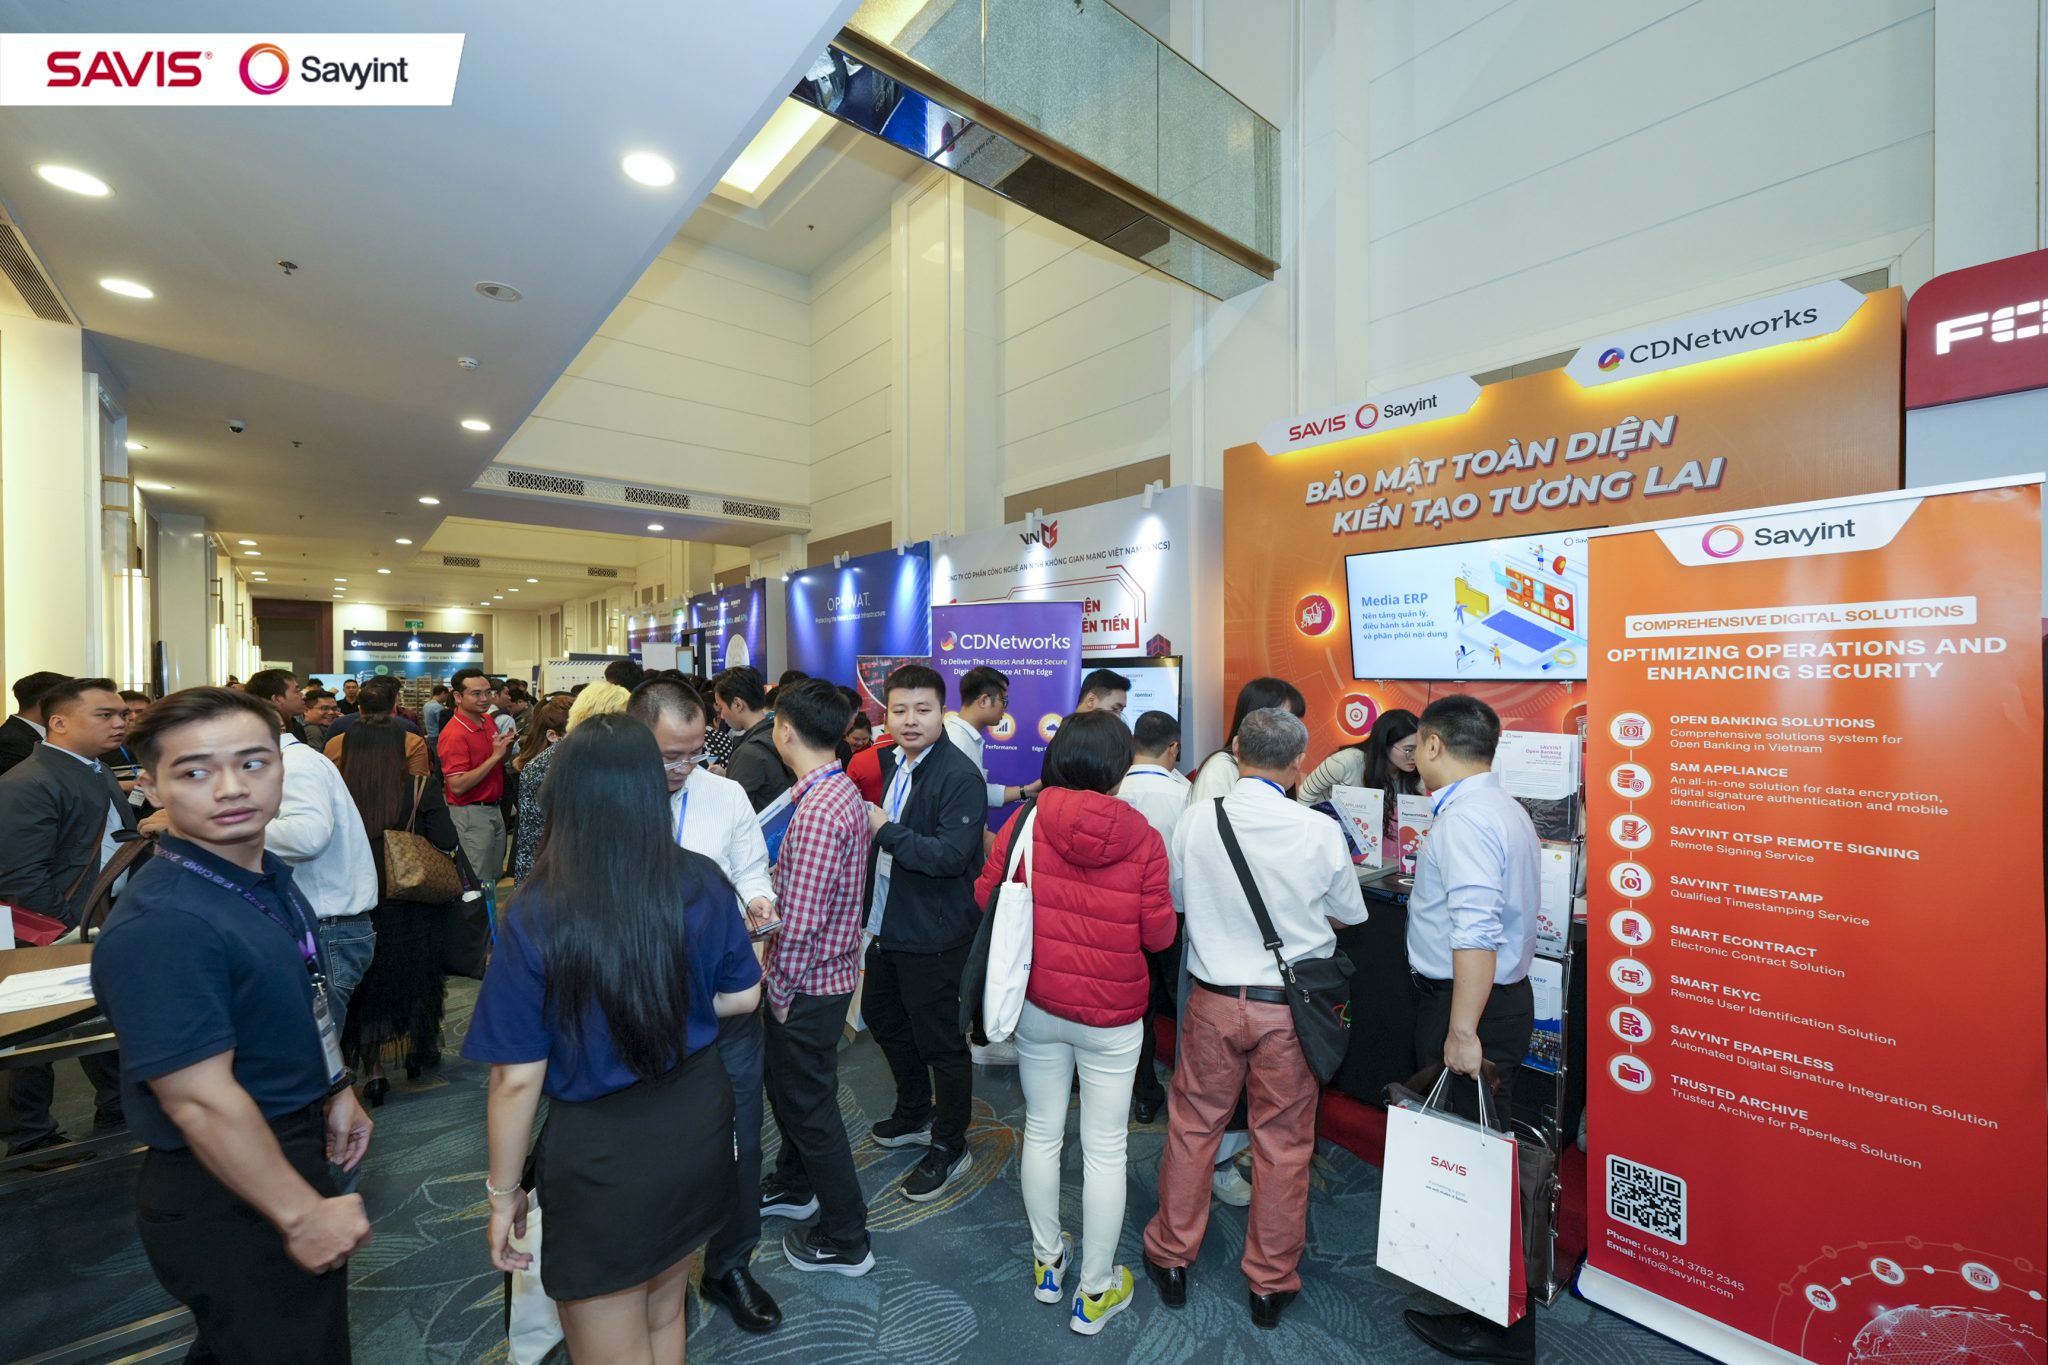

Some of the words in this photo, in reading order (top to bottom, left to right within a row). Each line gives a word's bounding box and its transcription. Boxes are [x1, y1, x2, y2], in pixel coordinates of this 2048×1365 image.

[1630, 307, 1818, 363] CDNetworks
[1289, 415, 1345, 441] SAVIS
[1384, 395, 1437, 418] Savyint
[1305, 470, 1367, 504] BẢO
[1374, 458, 1446, 496] MẬT
[1452, 438, 1556, 479] TOÀN
[1564, 415, 1678, 463] DIỆN
[1331, 498, 1404, 534] KIẾN
[1410, 494, 1480, 528] TẠO
[1488, 471, 1635, 515] TƯƠNG
[1643, 456, 1727, 496] LAI
[1754, 518, 1856, 547] Savyint
[1069, 553, 1085, 563] GIAN
[1362, 595, 1400, 607] Media
[1404, 593, 1428, 604] ERP
[1101, 613, 1129, 631] TIẾN
[1632, 615, 1767, 632] COMPREHENSIVE
[1771, 611, 1841, 625] DIGITAL
[1845, 605, 1964, 621] SOLUTIONS
[960, 634, 1070, 650] CDNetworks
[1427, 631, 1447, 639] dung
[1607, 645, 1740, 662] OPTIMIZING
[1746, 640, 1926, 660] OPERATIONS
[1936, 637, 2007, 654] AND
[1037, 669, 1053, 677] Edge
[1647, 665, 1791, 680] ENHANCING
[1798, 662, 1943, 680] SECURITY
[1670, 715, 1707, 725] OPEN
[1711, 716, 1778, 727] BANKING
[1781, 717, 1875, 728] SOLUTIONS
[1670, 729, 1762, 741] Comprehensive
[1766, 731, 1825, 742] solutions
[1829, 733, 1878, 745] system
[1882, 734, 1903, 744] for
[1670, 740, 1699, 750] Open
[1703, 741, 1750, 752] Banking
[1754, 742, 1765, 751] in
[1769, 743, 1822, 753] Vietnam
[1670, 762, 1699, 773] SAM
[1704, 765, 1788, 777] APPLIANCE
[1670, 776, 1684, 785] An
[1688, 777, 1745, 789] all-in-one
[1749, 780, 1799, 792] solution
[1803, 784, 1822, 794] for
[1826, 785, 1854, 795] data
[1859, 789, 1943, 803] encryption,
[1670, 786, 1704, 798] digital
[1708, 789, 1763, 803] signature
[1767, 793, 1863, 807] authentication
[1866, 801, 1893, 812] and
[1897, 802, 1948, 815] mobile
[1670, 798, 1745, 812] identification
[1670, 826, 1729, 840] SAVYINT
[1733, 832, 1772, 845] QTSP
[1777, 837, 1843, 851] REMOTE
[1847, 844, 1920, 860] SIGNING
[1670, 840, 1713, 851] Remote
[1716, 845, 1761, 859] Signing
[1765, 849, 1814, 863] Service
[1670, 876, 1729, 892] SAVYINT
[1733, 884, 1823, 903] TIMESTAMP
[1670, 889, 1721, 903] Qualified
[1725, 898, 1814, 919] Timestamping
[1818, 909, 1870, 926] Service
[1670, 925, 1719, 941] SMART
[1723, 934, 1817, 957] ECONTRACT
[1670, 939, 1728, 956] Electronic
[1732, 951, 1786, 967] Contract
[1790, 958, 1845, 978] Solution
[1670, 975, 1719, 993] SMART
[1723, 987, 1761, 1002] EKYC
[1670, 989, 1714, 1005] Remote
[1717, 999, 1745, 1013] User
[1749, 1006, 1834, 1031] Identification
[1839, 1024, 1897, 1047] Solution
[1670, 1025, 1730, 1047] SAVYINT
[1734, 1041, 1834, 1072] EPAPERLESS
[1670, 1039, 1734, 1063] Automated
[1736, 1055, 1777, 1074] Digital
[1779, 1066, 1844, 1090] Signature
[1848, 1083, 1927, 1112] Integration
[1931, 1104, 1999, 1130] Solution
[1670, 1074, 1736, 1100] TRUSTED
[1739, 1096, 1809, 1120] ARCHIVE
[1670, 1088, 1714, 1109] Trusted
[1718, 1102, 1764, 1124] Archive
[1768, 1116, 1786, 1129] for
[1790, 1123, 1857, 1151] Paperless
[1861, 1142, 1922, 1169] Solution
[1431, 1156, 1467, 1176] SAVIS
[1606, 1228, 1641, 1249] Phone:
[1643, 1243, 1670, 1262] (+84)
[1673, 1253, 1685, 1265] 24
[1687, 1257, 1715, 1277] 3782
[1717, 1270, 1745, 1291] 2345
[1606, 1240, 1636, 1260] Email:
[1639, 1251, 1734, 1299] info@savyint.com
